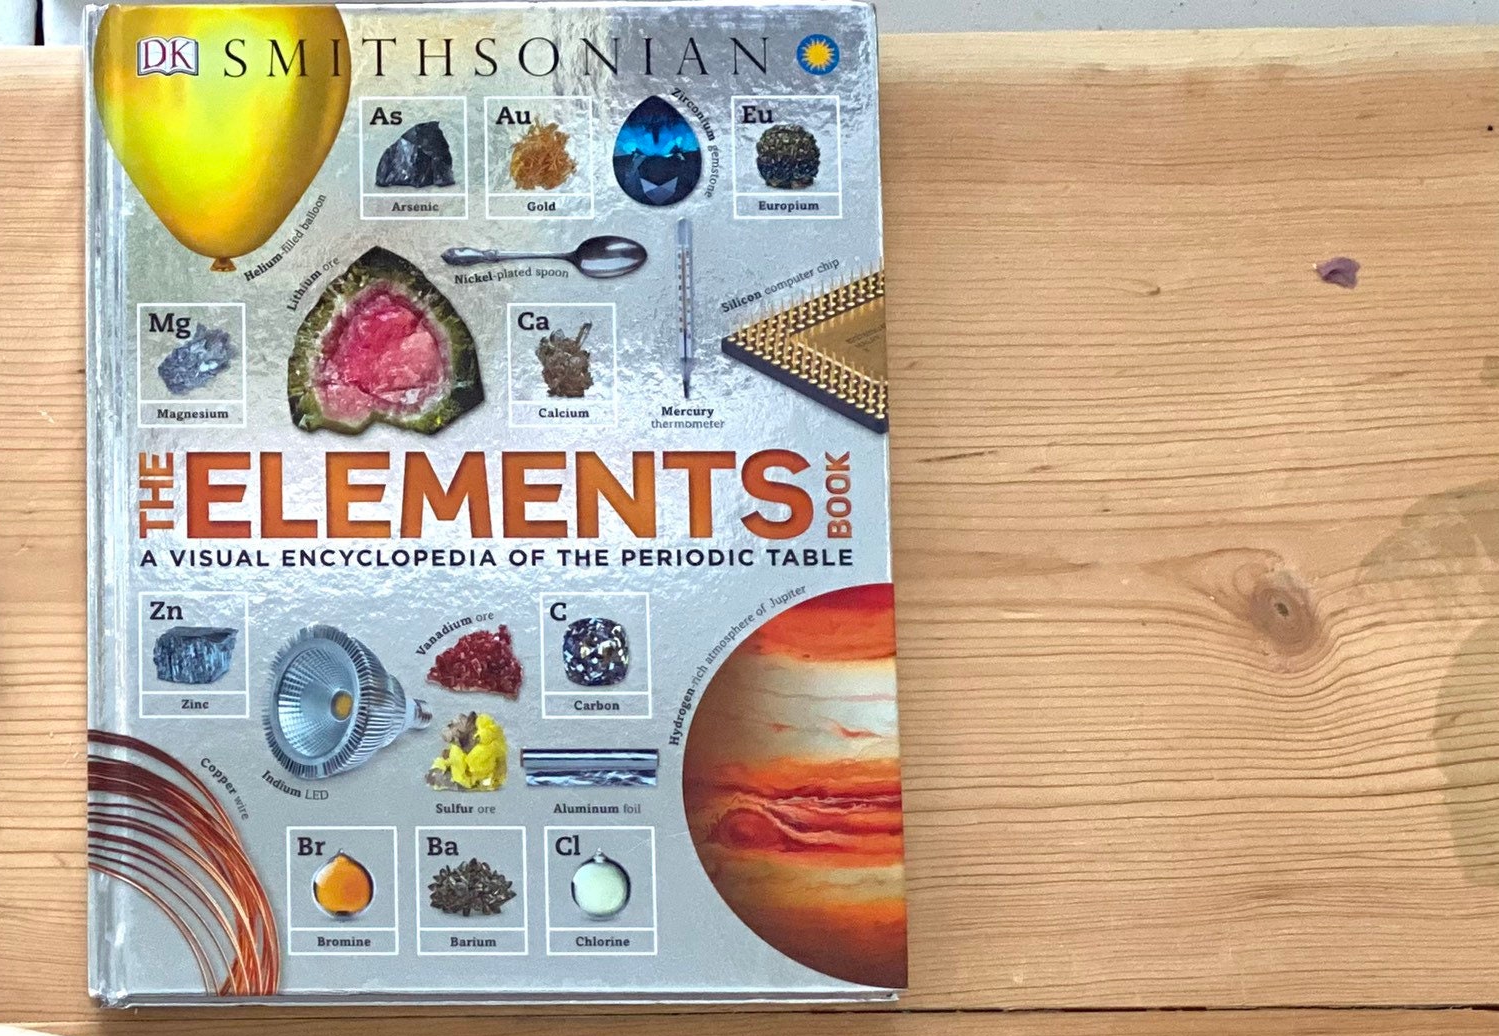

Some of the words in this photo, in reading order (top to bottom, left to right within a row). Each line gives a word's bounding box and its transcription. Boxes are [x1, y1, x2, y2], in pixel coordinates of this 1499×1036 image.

[142, 42, 193, 70] DK
[223, 36, 770, 78] SMITHSONIAN
[369, 107, 403, 126] As
[495, 106, 532, 126] Au
[742, 105, 775, 125] Eu
[671, 87, 716, 142] Zirconium
[704, 144, 722, 199] gemstone
[391, 201, 439, 213] Arsenic
[527, 200, 557, 212] Gold
[758, 200, 820, 214] Europium
[243, 229, 304, 282] Helium-filled
[300, 193, 327, 232] balloon
[286, 268, 322, 312] Lithium
[322, 256, 341, 272] ore
[454, 267, 533, 285] Nickel-plated
[535, 268, 570, 281] spoon
[720, 288, 763, 314] Silicon
[763, 267, 815, 297] computer
[816, 257, 840, 279] chip
[148, 313, 191, 338] Mg
[517, 312, 550, 331] Ca
[156, 409, 229, 422] Magnesium
[538, 408, 590, 419] Calcium
[661, 405, 714, 418] Mercury
[650, 418, 725, 430] thermometer
[138, 451, 174, 538] THE
[186, 449, 814, 540] ELEMENTS
[824, 450, 853, 539] BOOK
[139, 549, 158, 567] A
[170, 549, 270, 567] VISUAL
[282, 549, 498, 567] ENCYCLOPEDIA
[509, 548, 545, 567] OF
[557, 548, 609, 567] THE
[622, 548, 754, 567] PERIODIC
[766, 549, 853, 567] TABLE
[149, 602, 184, 621] Zn
[550, 601, 567, 621] C
[415, 614, 473, 657] Vanadium
[475, 611, 494, 622] ore
[668, 668, 708, 746] Hydrogen-rich
[705, 613, 755, 665] atmosphere
[755, 602, 770, 617] of
[769, 584, 807, 609] Jupiter
[181, 698, 209, 710] Zinc
[574, 700, 620, 711] Carbon
[200, 757, 237, 796] Copper
[233, 795, 249, 821] wire
[261, 769, 302, 798] Indium
[304, 789, 329, 800] LED
[435, 802, 473, 814] Sulfur
[477, 805, 496, 815] ore
[553, 803, 619, 815] Aluminum
[622, 802, 641, 814] foil
[297, 837, 325, 856] Br
[426, 836, 459, 856] Ba
[554, 835, 581, 856] Cl
[317, 936, 371, 948] Bromine
[450, 936, 497, 948] Barium
[575, 936, 630, 948] Chlorine
